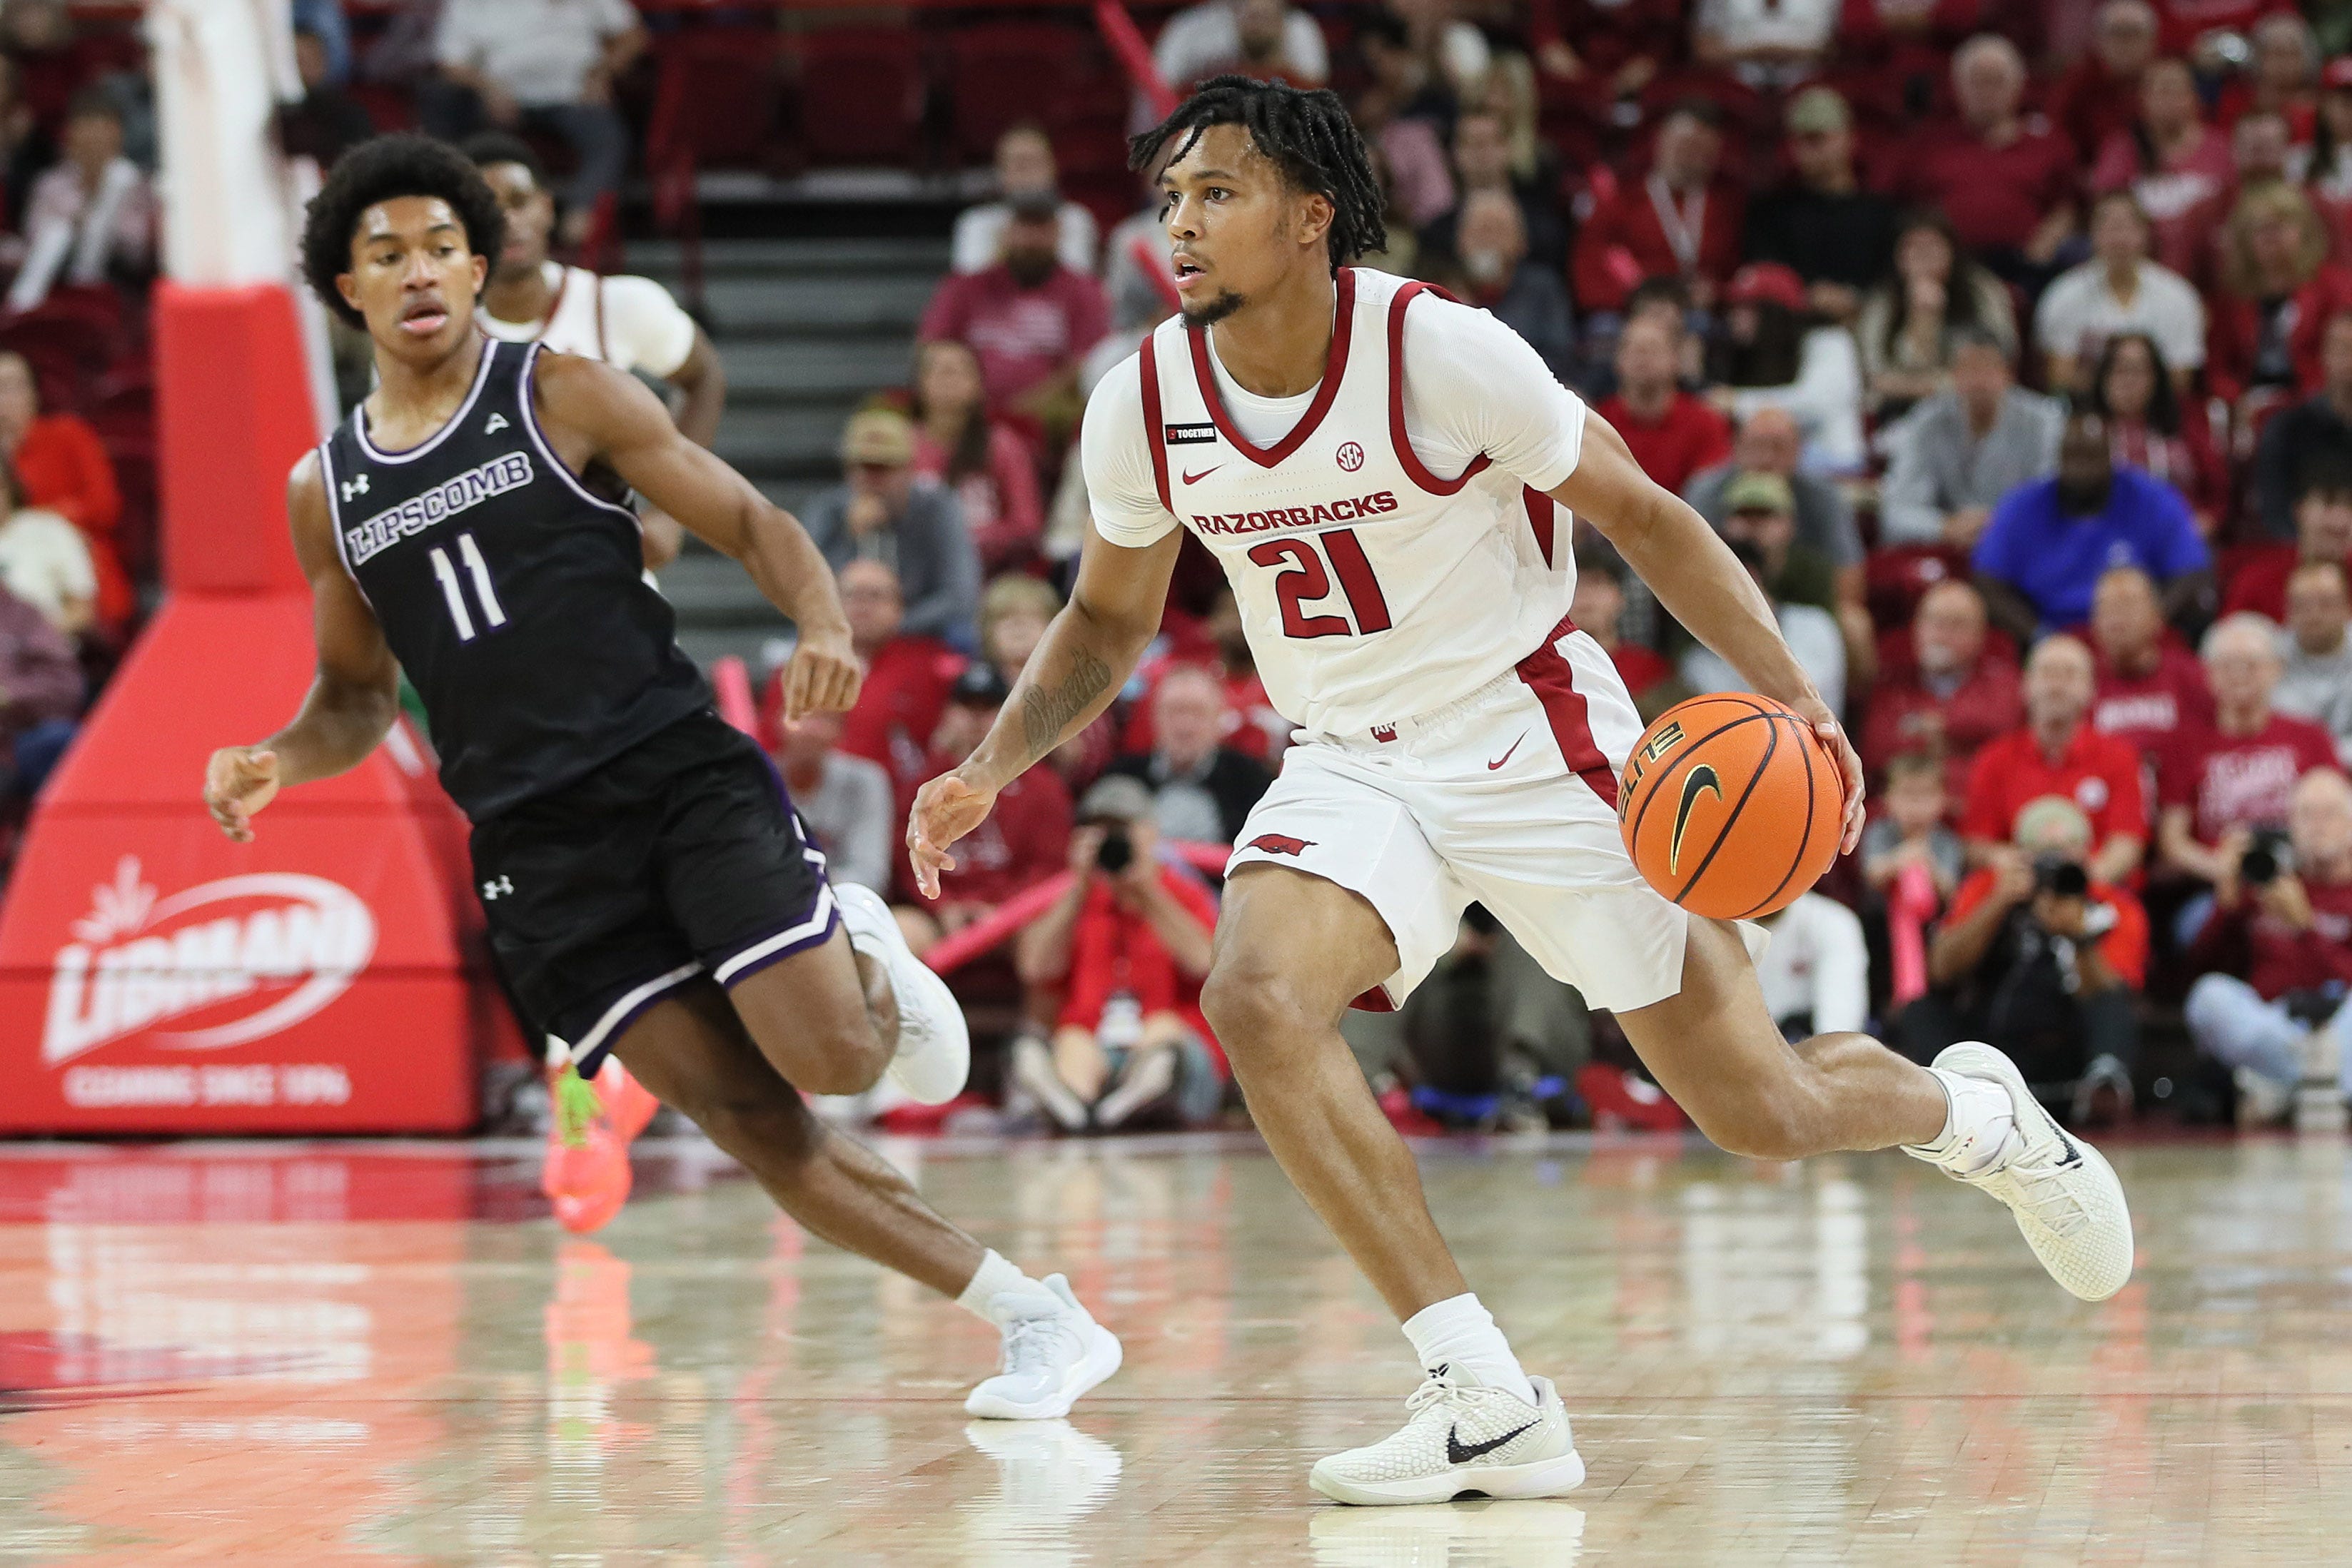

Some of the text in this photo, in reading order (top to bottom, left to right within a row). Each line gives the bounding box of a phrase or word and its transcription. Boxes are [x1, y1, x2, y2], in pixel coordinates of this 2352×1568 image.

[1176, 428, 1215, 439] TOGETHER
[1336, 442, 1364, 472] SEC
[345, 450, 535, 566] LIPSCOMB
[1191, 491, 1399, 535] RAZORBACKS
[428, 532, 508, 642] 11
[1247, 528, 1393, 639] 21
[1619, 721, 1686, 824] ELITE
